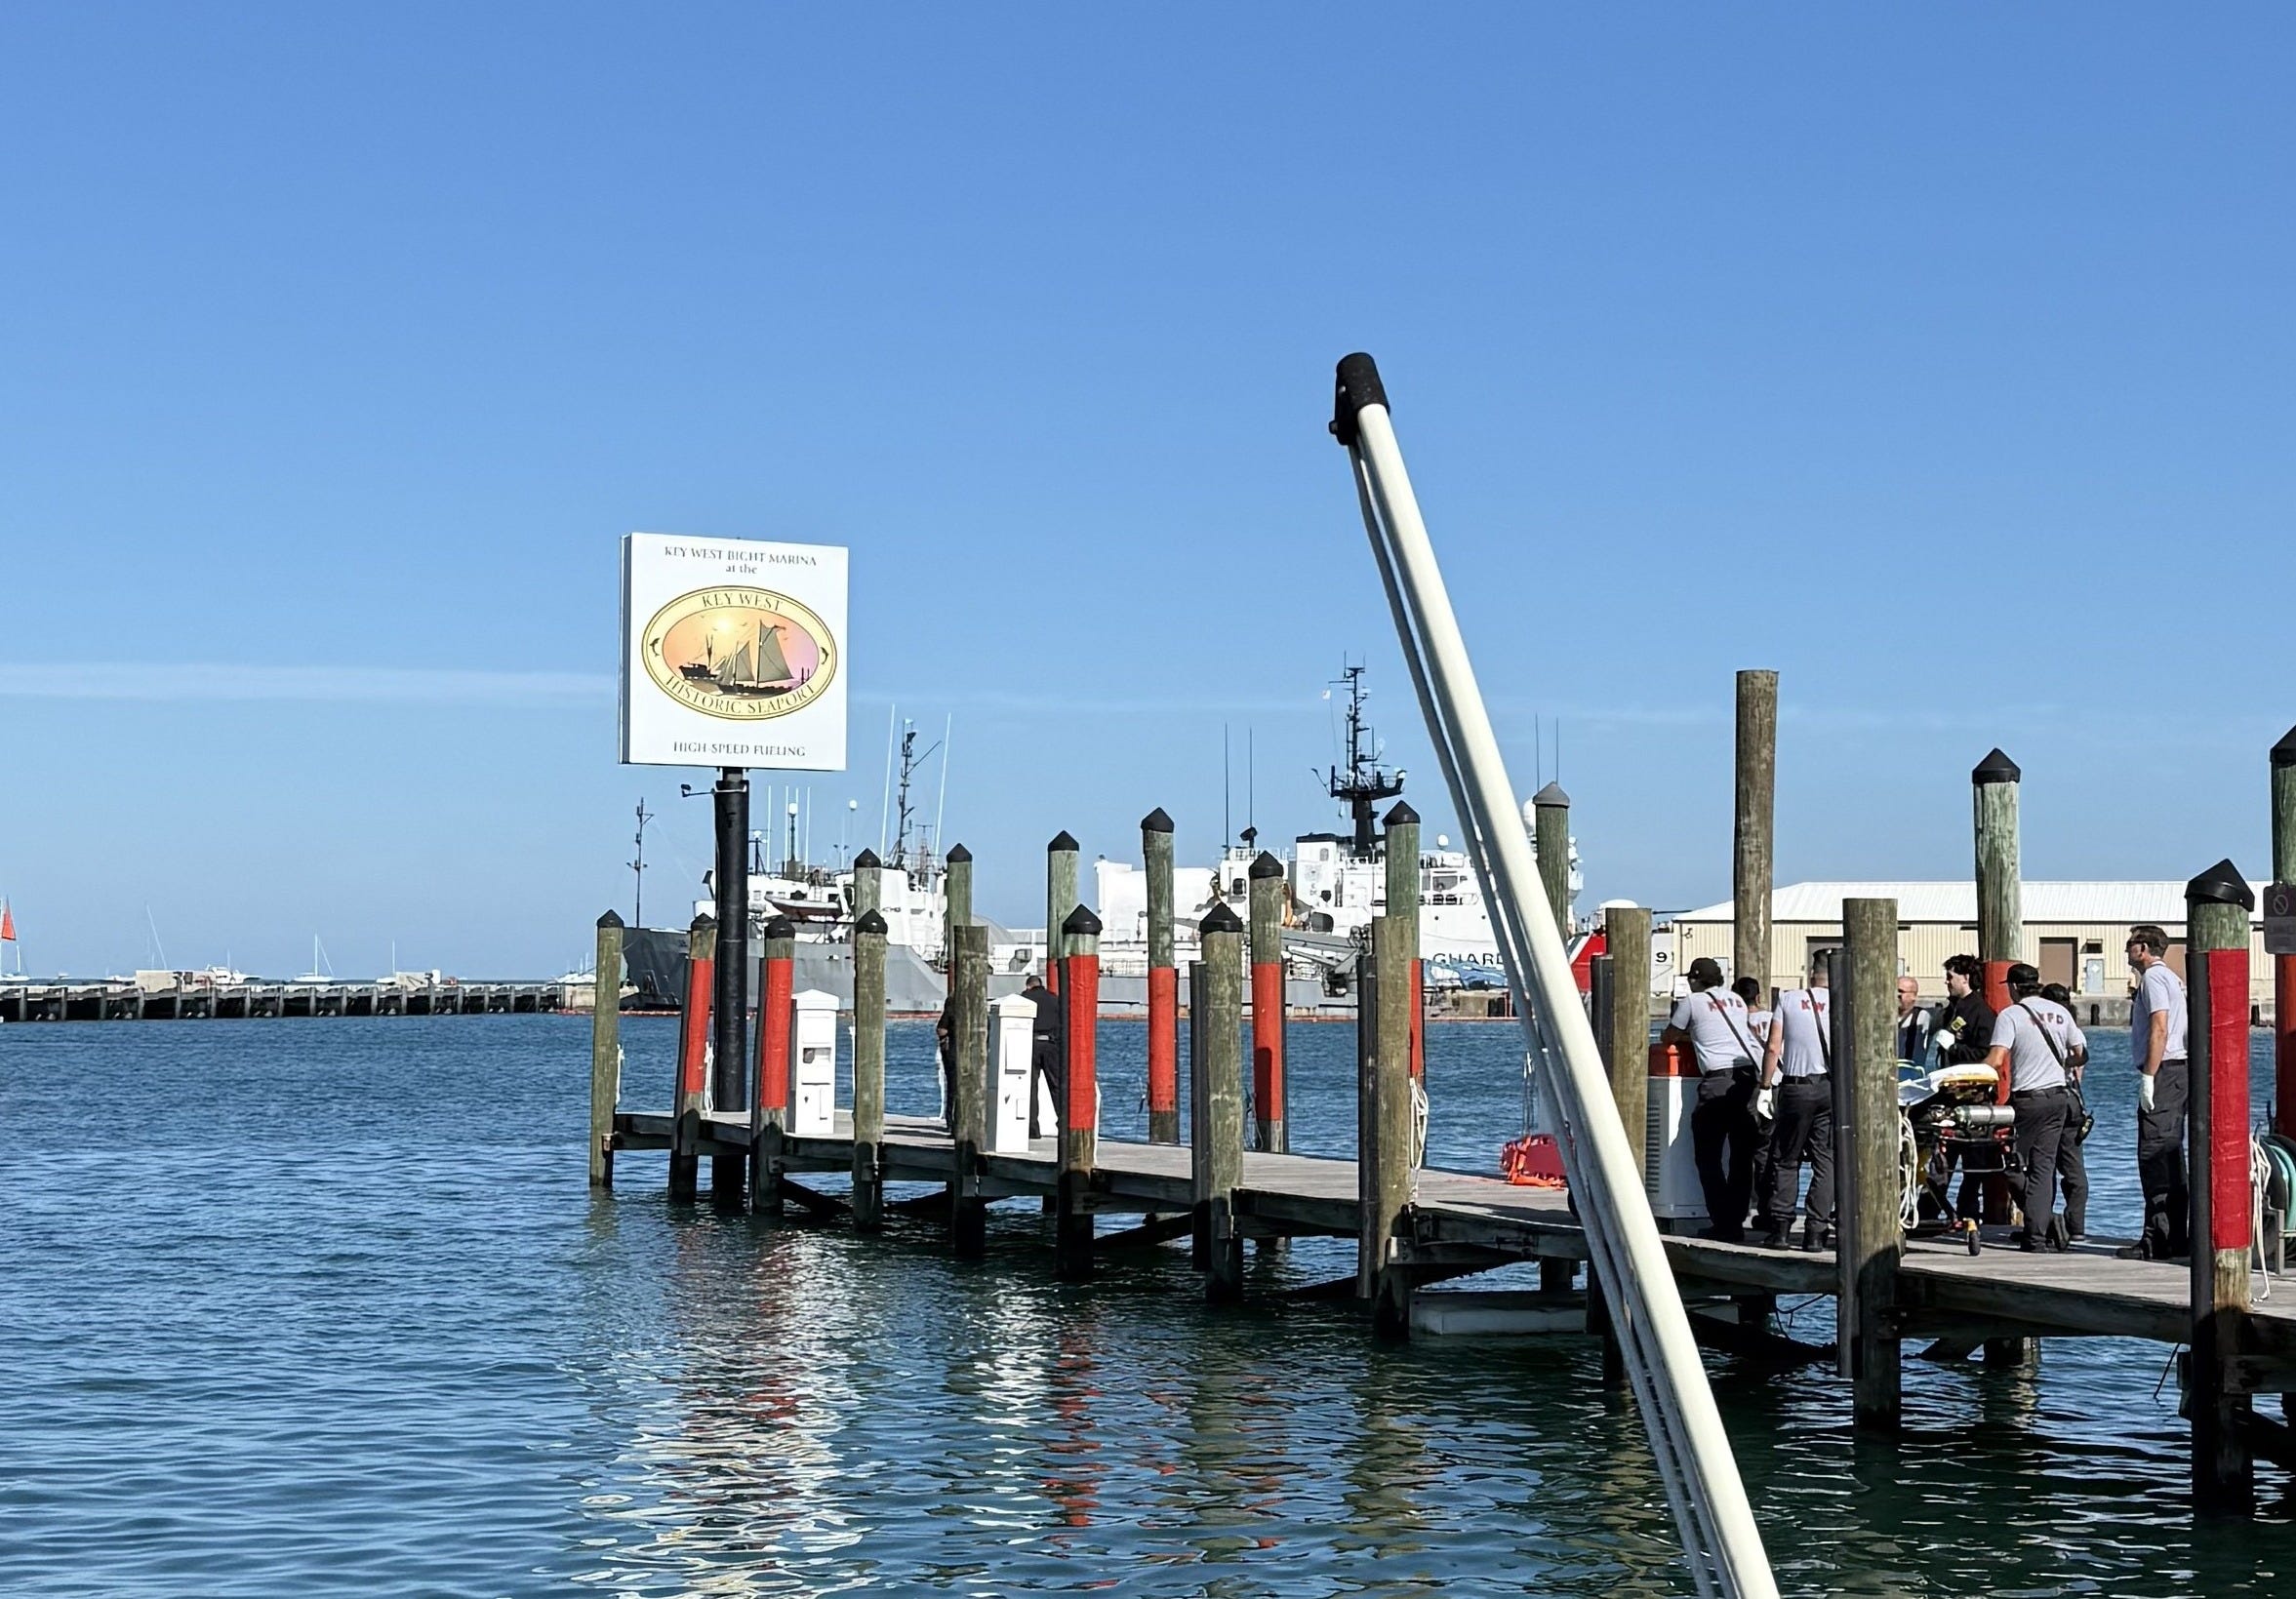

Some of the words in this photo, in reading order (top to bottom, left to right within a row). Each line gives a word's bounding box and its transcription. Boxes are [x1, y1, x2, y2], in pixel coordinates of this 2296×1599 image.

[665, 546, 688, 557] KEY
[691, 547, 722, 560] WEST
[727, 550, 766, 563] BIGHT
[768, 553, 817, 566] MARINA
[740, 564, 757, 575] the
[703, 592, 733, 607] KEY
[740, 593, 783, 611] WEST
[665, 676, 742, 714] HISTORIC
[747, 684, 815, 714] SEAPORT
[753, 744, 806, 757] FUELING
